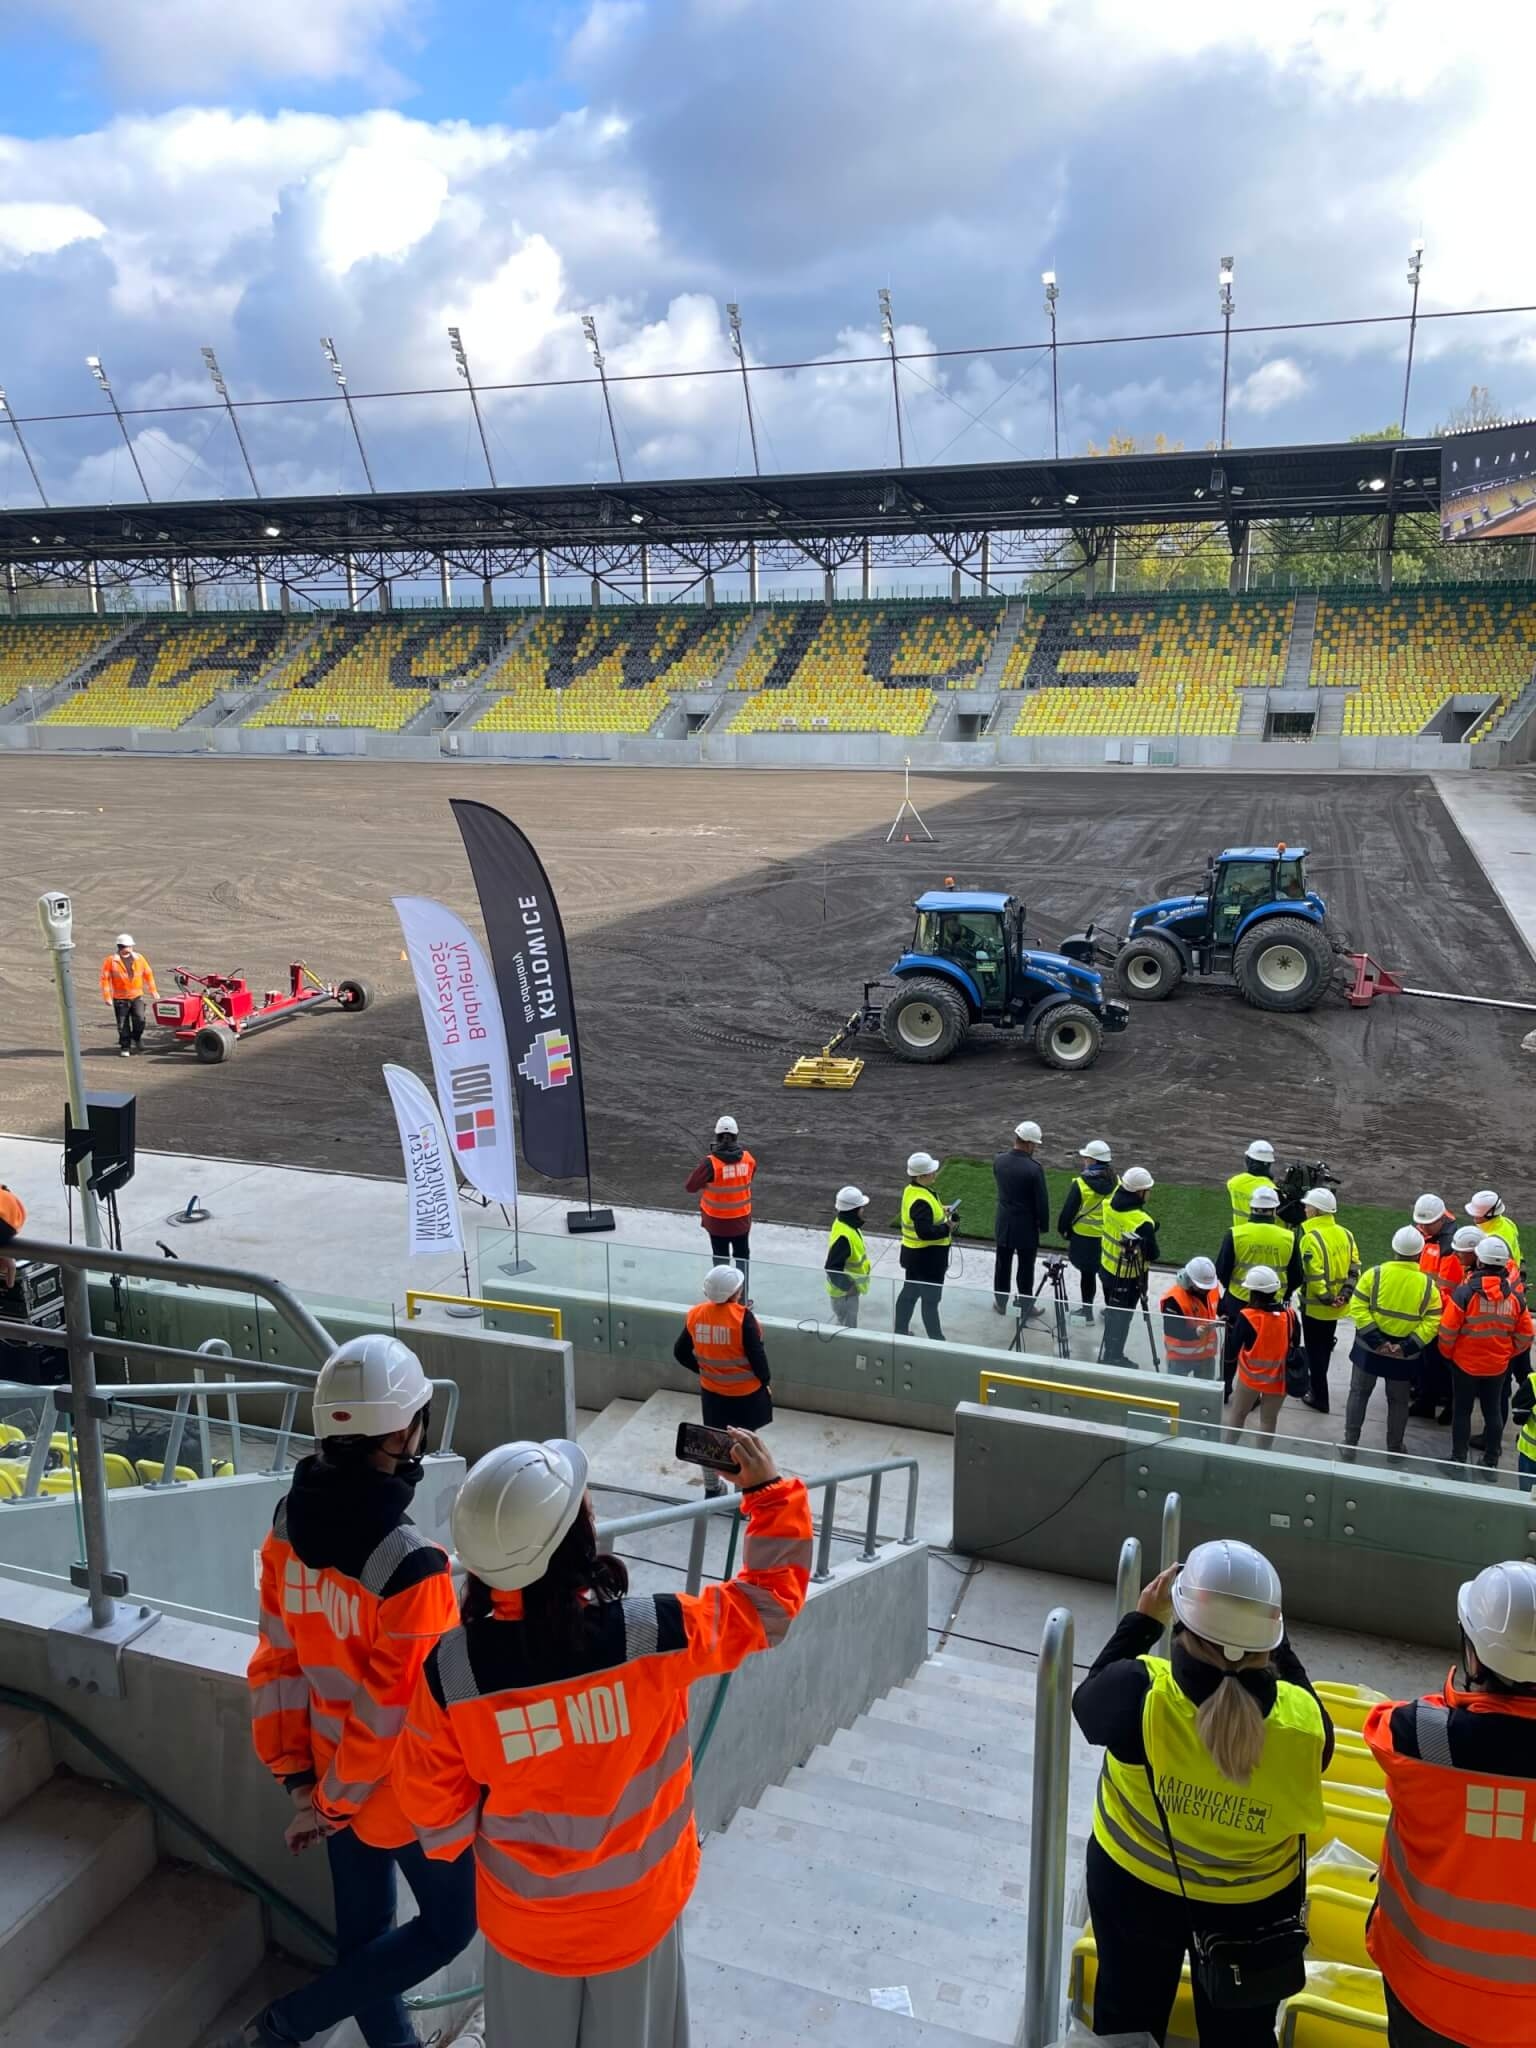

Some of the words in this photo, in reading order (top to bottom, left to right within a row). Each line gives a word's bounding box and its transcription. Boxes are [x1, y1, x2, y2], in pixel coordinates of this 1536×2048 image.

[712, 1325, 731, 1345] NDI
[321, 1577, 361, 1640] NDI
[565, 1680, 631, 1745] NDI
[1158, 1775, 1249, 1814] KATOWICKIE
[1158, 1794, 1243, 1830] NWESTYCJE
